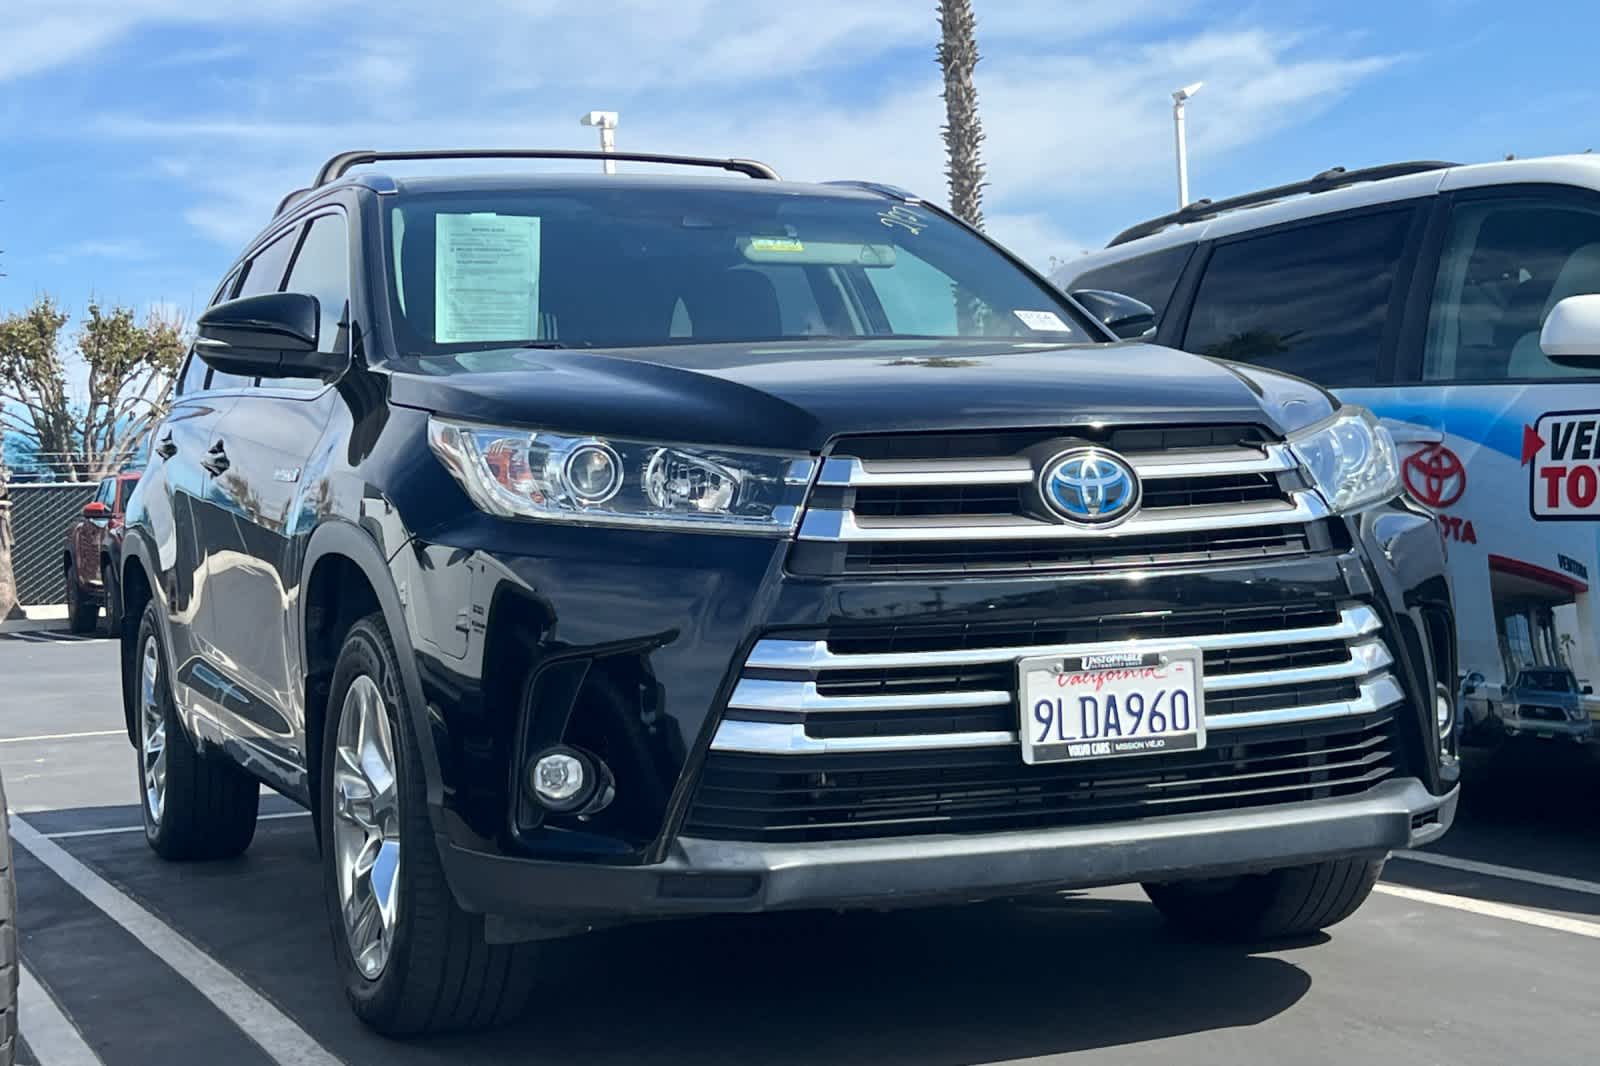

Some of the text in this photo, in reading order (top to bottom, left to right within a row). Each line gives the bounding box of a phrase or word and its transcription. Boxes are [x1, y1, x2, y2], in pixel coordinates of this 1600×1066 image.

[1541, 465, 1600, 509] TO
[1056, 667, 1168, 692] California
[1034, 688, 1190, 743] 9LDA960
